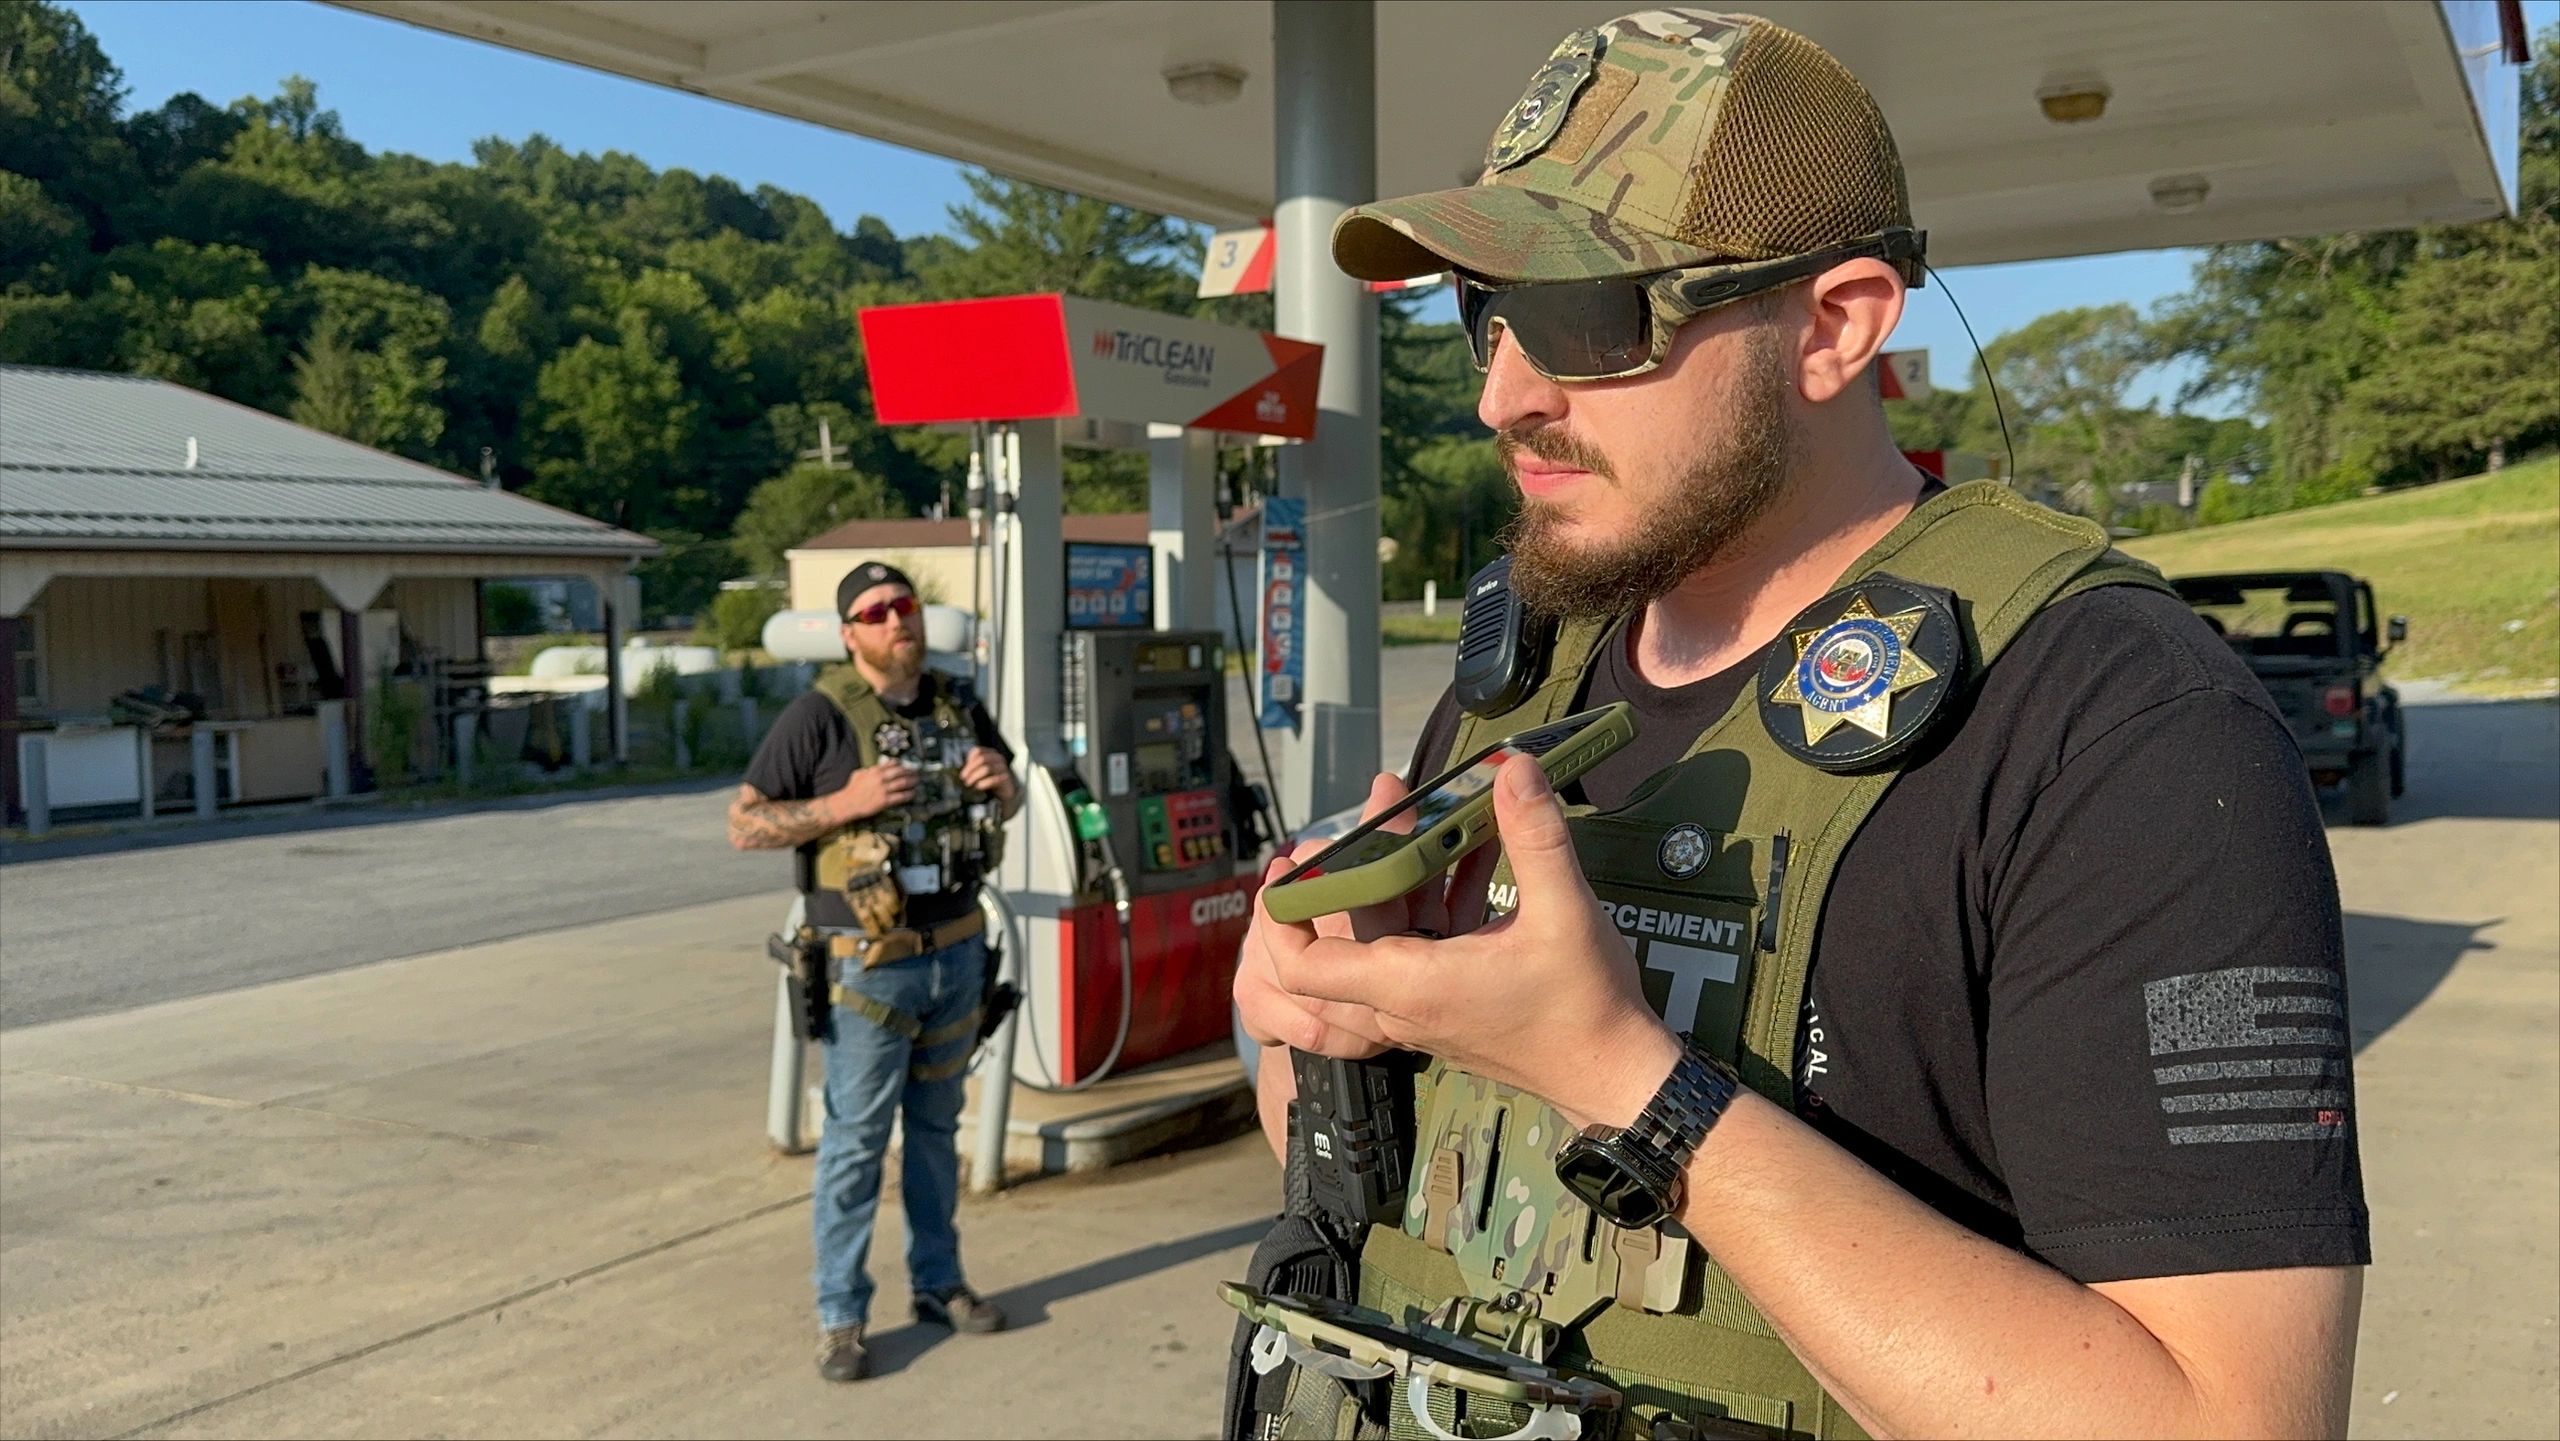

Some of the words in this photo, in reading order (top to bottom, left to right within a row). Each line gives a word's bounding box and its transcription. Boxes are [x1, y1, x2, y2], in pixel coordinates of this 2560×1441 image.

[1219, 239, 1238, 269] 3
[1115, 330, 1215, 373] TriCLEAN
[1906, 358, 1922, 382] 2
[1805, 690, 1849, 712] AGENT
[1191, 890, 1247, 927] CITGO
